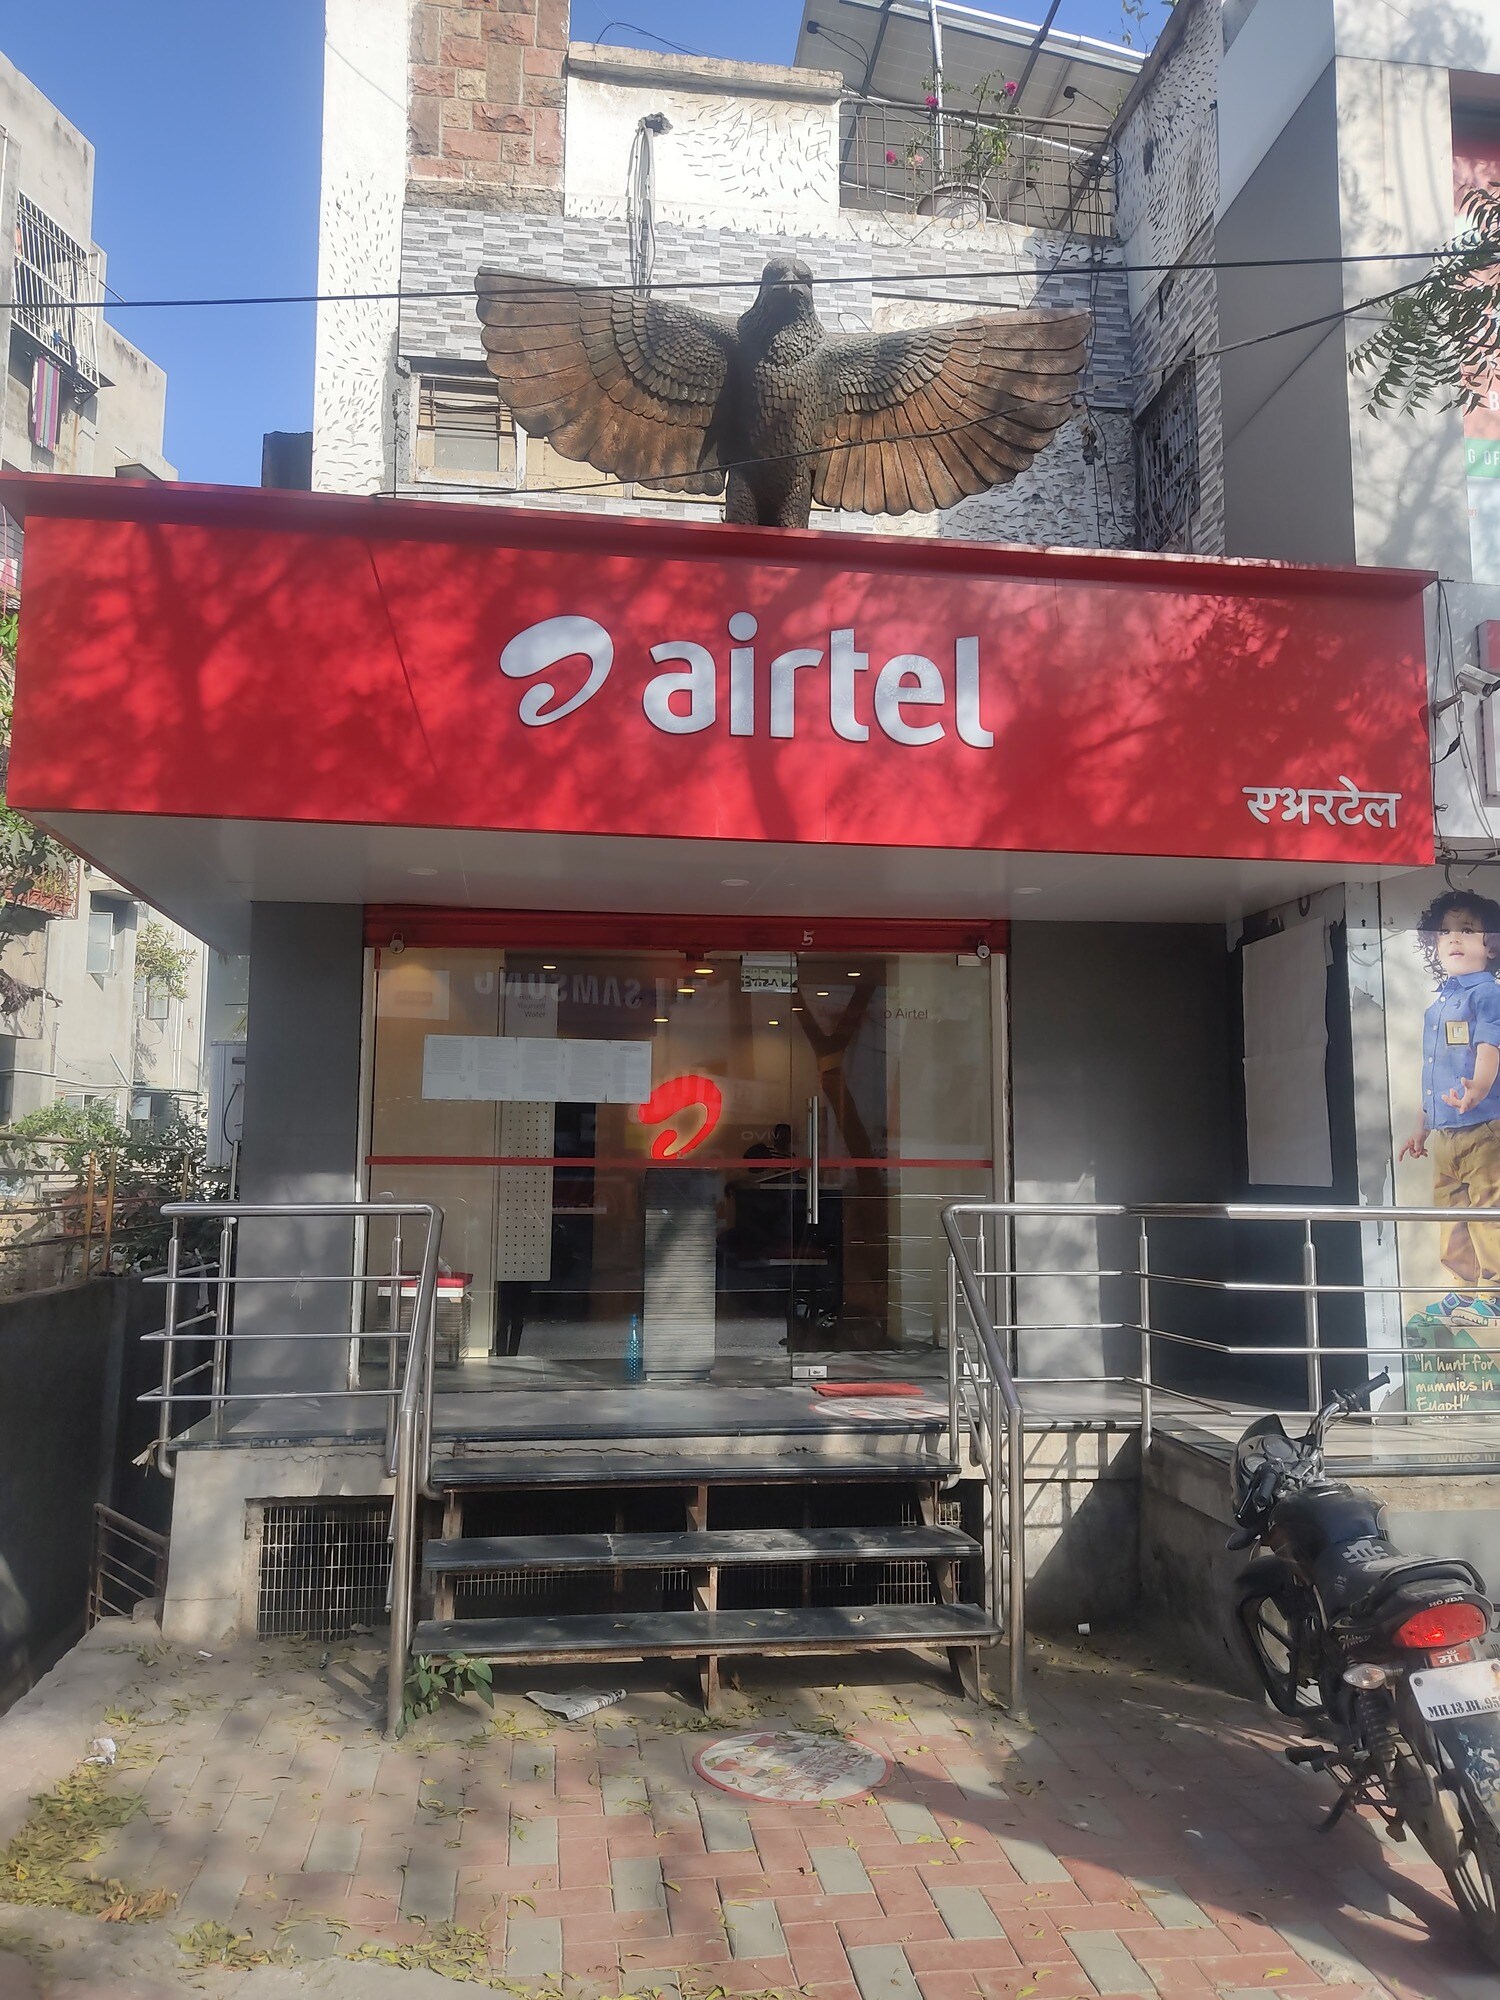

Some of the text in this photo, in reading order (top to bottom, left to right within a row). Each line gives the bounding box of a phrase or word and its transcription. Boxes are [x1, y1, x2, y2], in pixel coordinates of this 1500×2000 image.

[642, 611, 994, 748] airtel
[1242, 775, 1402, 828] एअरटेल
[801, 930, 815, 946] 5
[895, 1008, 928, 1020] Airtel
[1437, 1353, 1470, 1372] hunt
[1472, 1353, 1495, 1372] for
[1416, 1376, 1494, 1392] mummies in
[801, 1771, 842, 1795] SAFE
